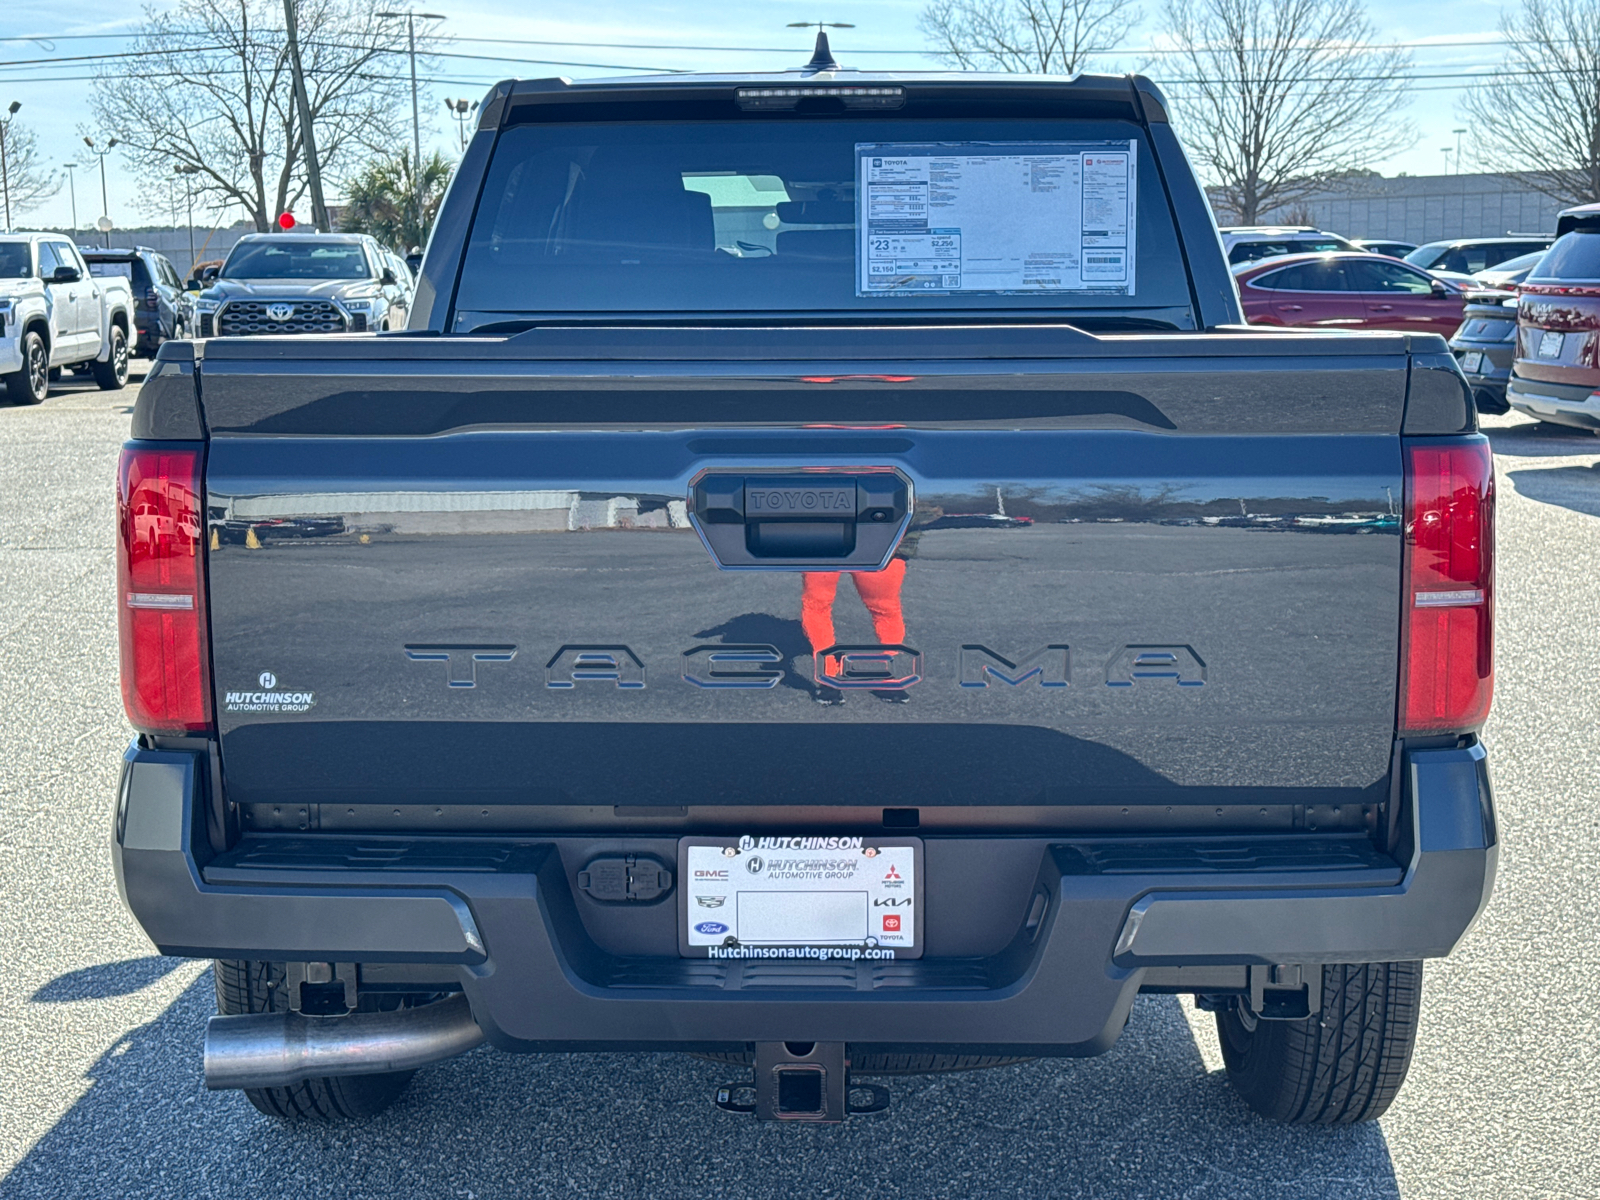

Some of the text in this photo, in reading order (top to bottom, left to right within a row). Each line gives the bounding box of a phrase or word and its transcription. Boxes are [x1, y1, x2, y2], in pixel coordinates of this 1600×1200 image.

[875, 240, 889, 250] 23
[750, 491, 851, 510] TOYOTA
[403, 642, 1209, 691] TACOMA
[225, 692, 313, 704] HUTCHINSON
[758, 836, 863, 850] HUTCHINSON
[767, 859, 858, 871] HUTCHINSON
[768, 871, 853, 879] AUTOMOTIVE GROUP
[874, 897, 911, 907] KIA
[701, 923, 722, 933] Ford
[708, 946, 895, 961] Hutchinsonautogroup.com
